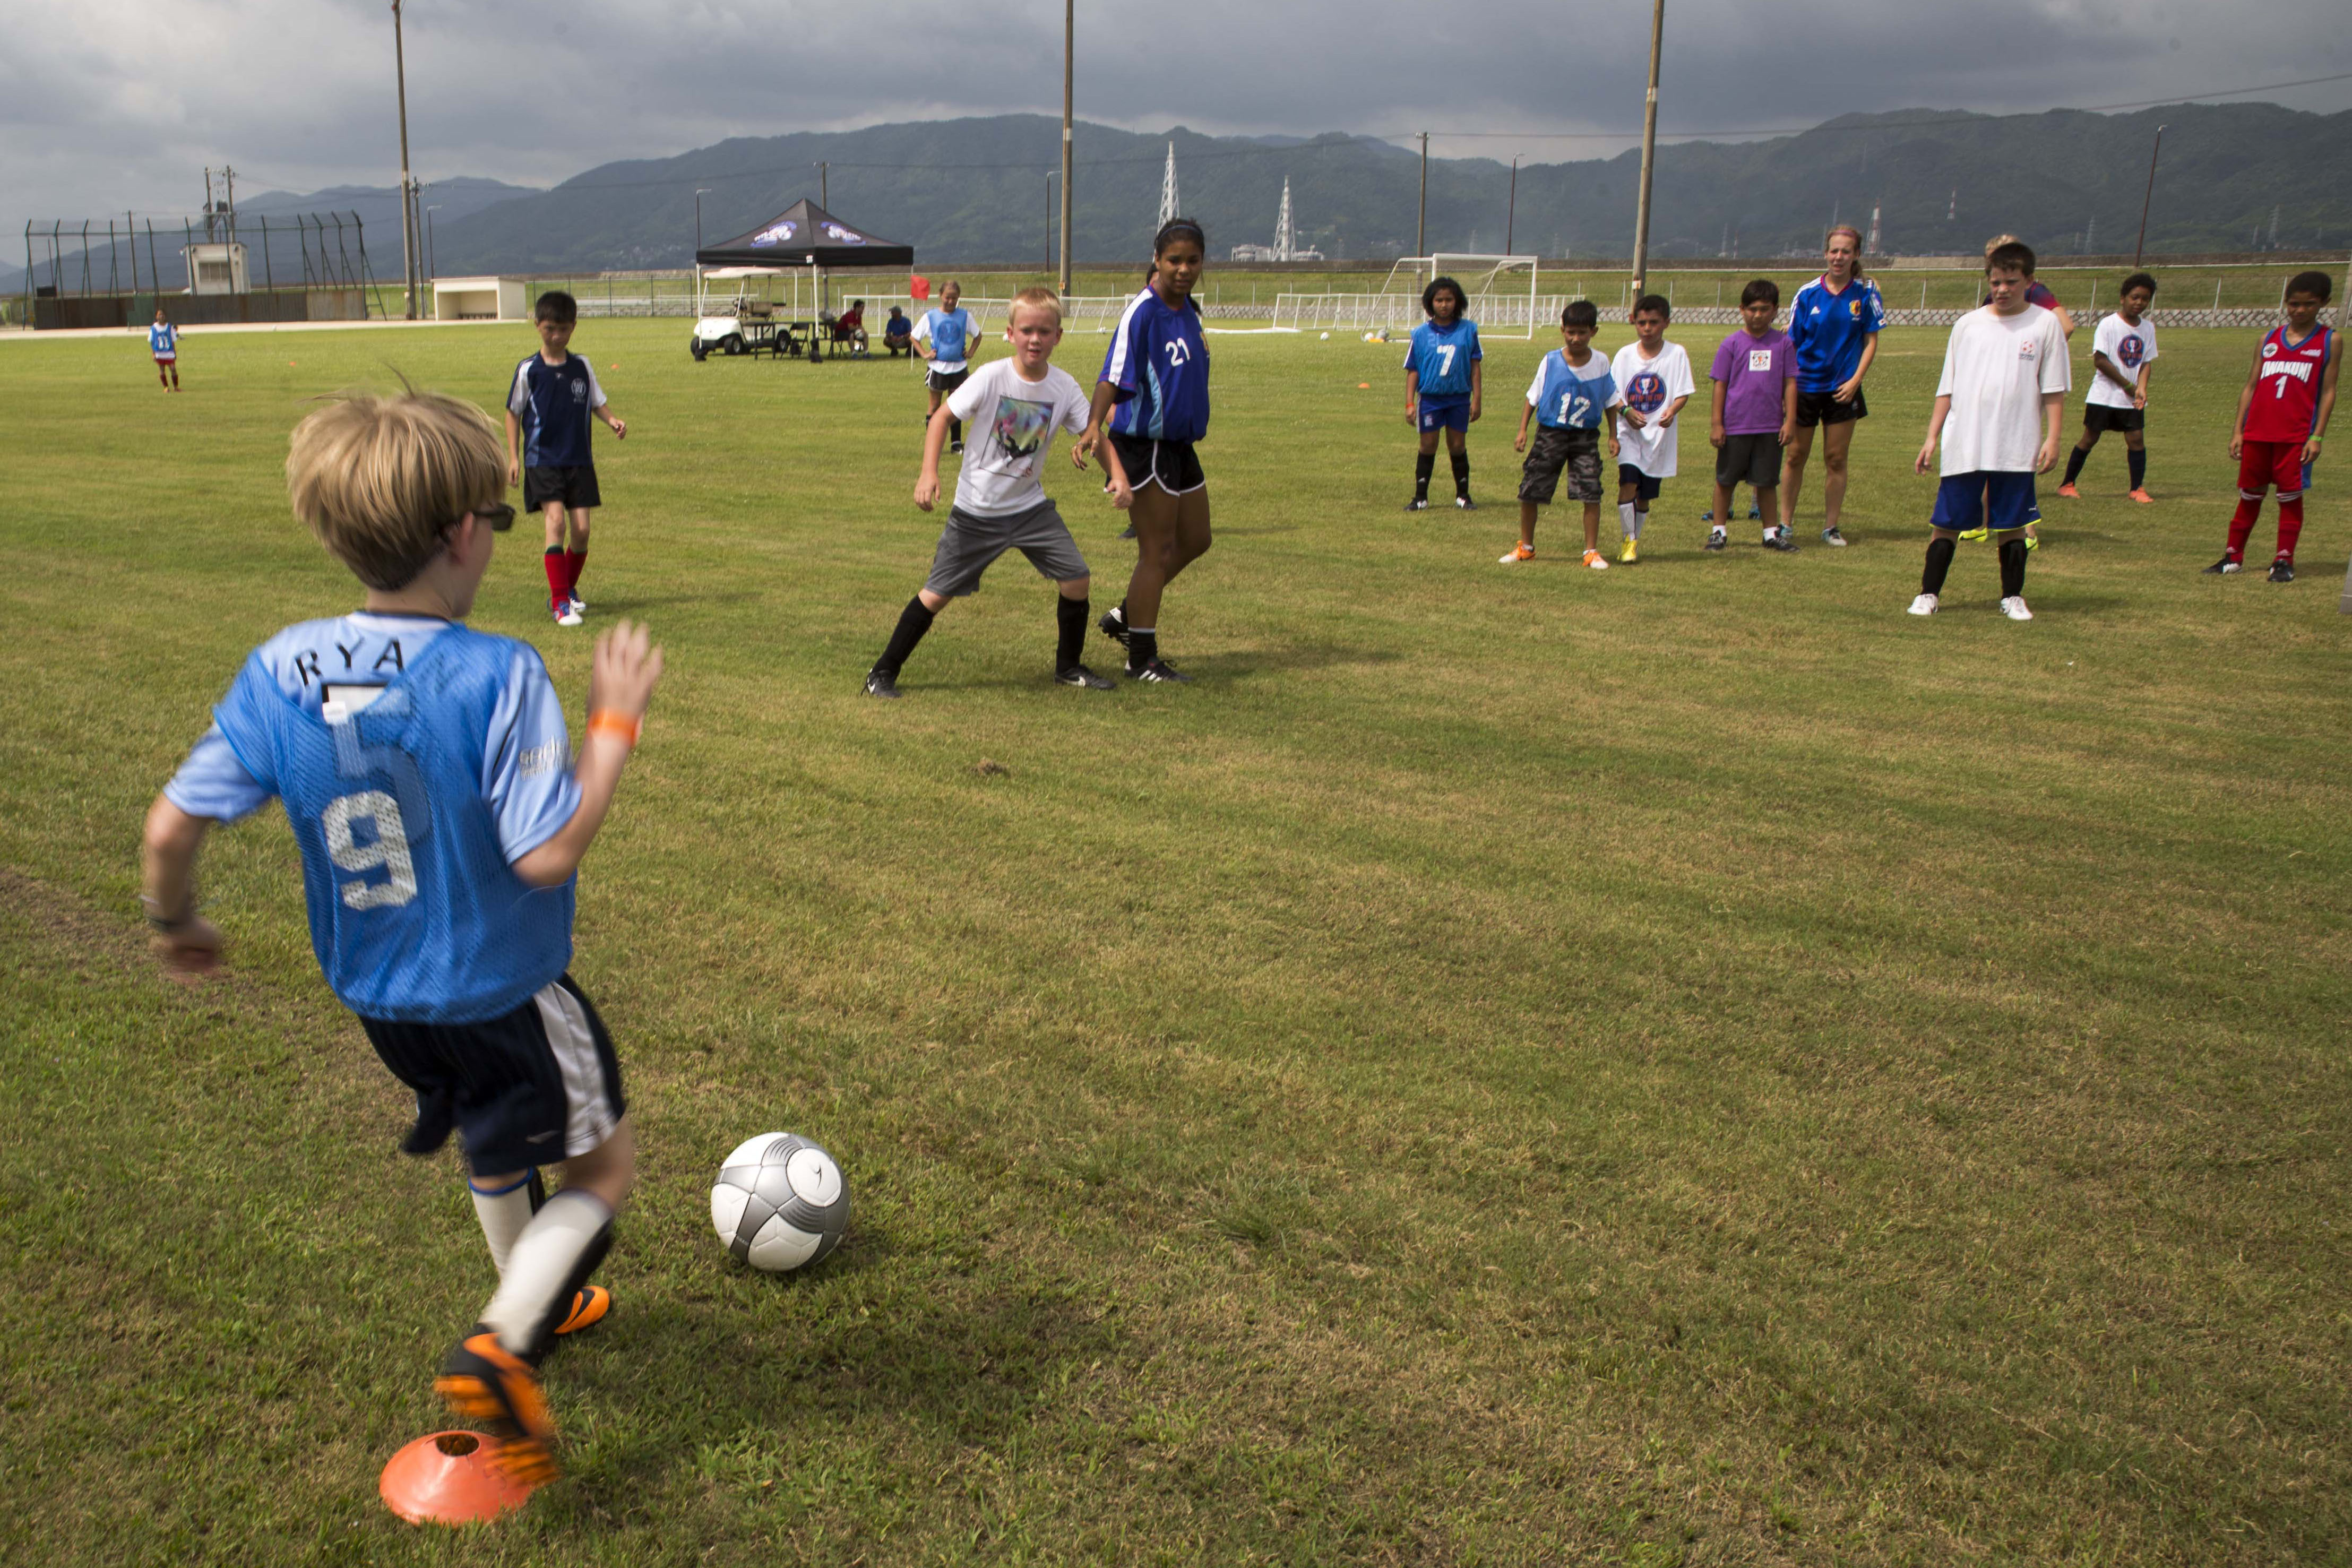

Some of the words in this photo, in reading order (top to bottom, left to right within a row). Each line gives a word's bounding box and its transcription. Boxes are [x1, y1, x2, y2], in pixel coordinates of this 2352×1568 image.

[1165, 337, 1190, 367] 21
[1436, 344, 1455, 376] 7
[2260, 360, 2313, 383] IWAKUNI
[2276, 375, 2288, 399] 1
[1556, 392, 1590, 428] 12
[322, 789, 418, 911] 9
